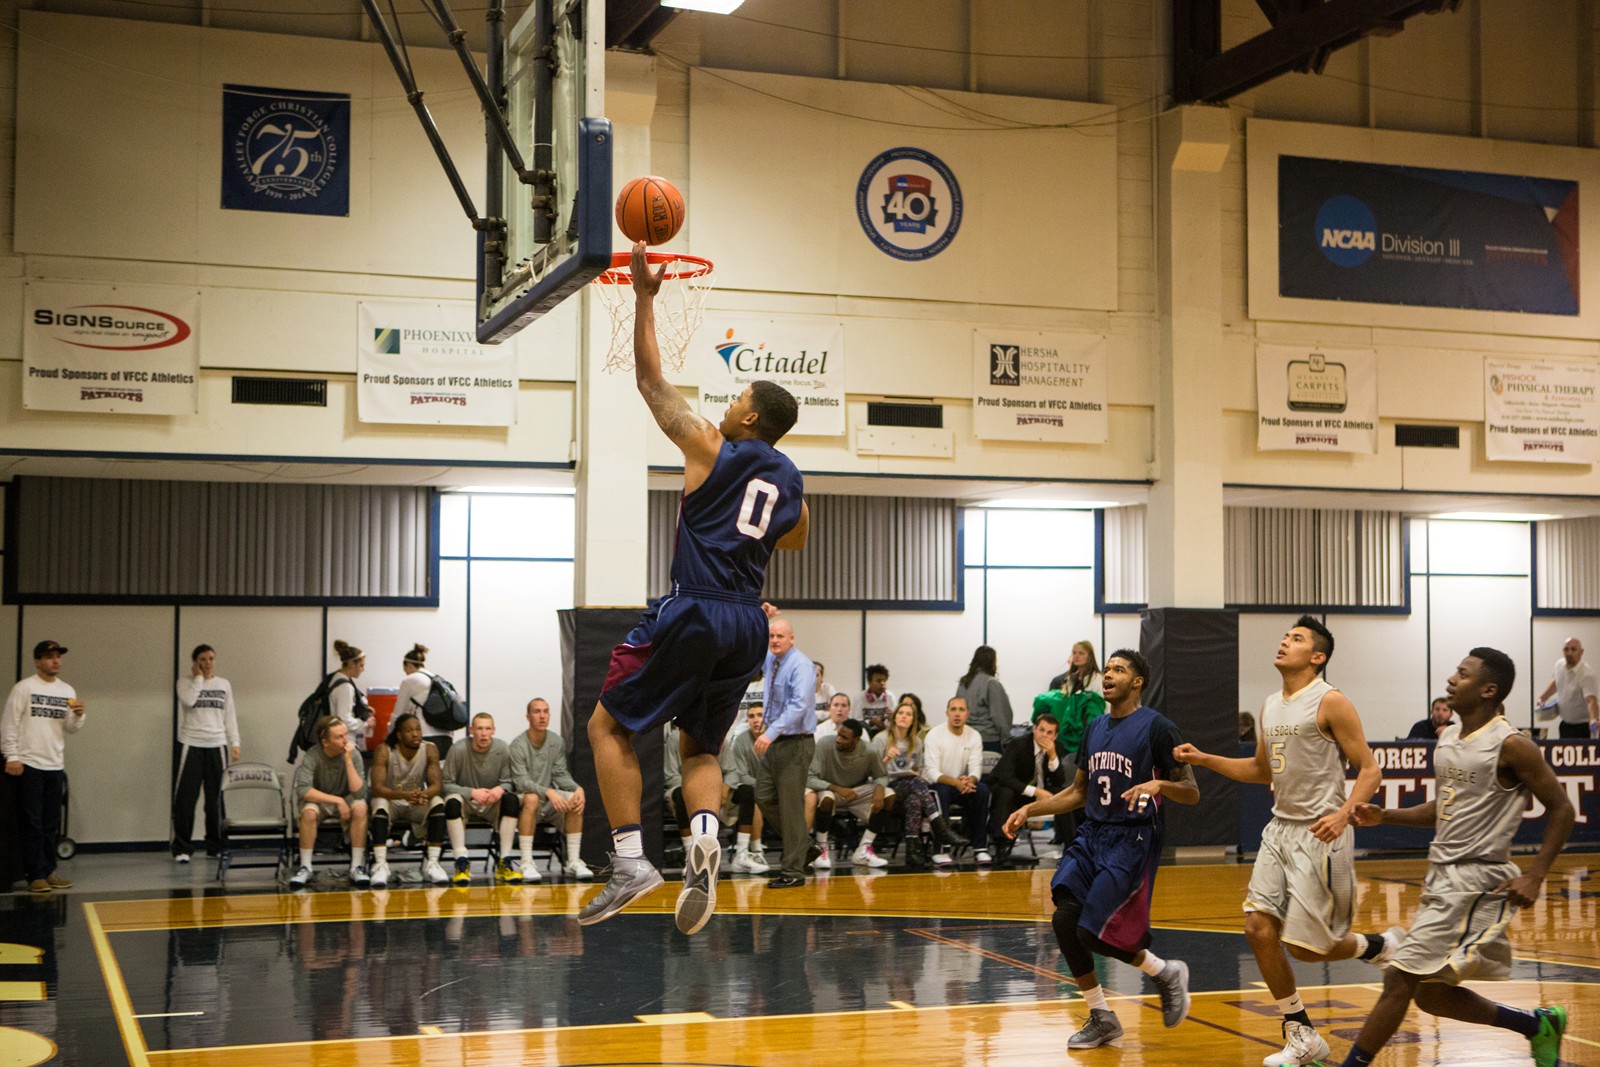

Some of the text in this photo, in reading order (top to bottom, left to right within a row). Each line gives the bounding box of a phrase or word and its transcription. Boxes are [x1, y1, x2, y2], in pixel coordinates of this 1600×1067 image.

[270, 101, 330, 133] CHRISTIAN
[887, 191, 931, 221] 40
[1321, 228, 1376, 251] NCAA
[1381, 233, 1444, 256] Division
[403, 329, 476, 342] PHOENIXV
[422, 347, 485, 356] HOSPITAL
[1020, 347, 1059, 358] HERSHA
[735, 348, 828, 374] Citadel
[1020, 361, 1091, 374] HOSPITALITY
[29, 367, 194, 384] Proud Sponsors of VFCC Athletics
[364, 373, 513, 388] Proud Sponsors of VFCC Athletics
[1020, 376, 1084, 387] MANAGEMENT
[1295, 381, 1340, 391] CARPETS
[1507, 383, 1595, 395] PHYSICAL THERAPY
[80, 390, 143, 402] PATRIOTS
[410, 395, 466, 406] PATRIOTS
[704, 393, 728, 403] Proud
[804, 397, 839, 407] Athletics
[978, 396, 1102, 411] Proud Sponsors of VFCC Athletics
[1016, 417, 1064, 427] PATRIOTS
[1261, 416, 1374, 431] Proud Sponsors of VFCC Athletics
[1489, 424, 1598, 438] Proud Sponsors of VFCC Athletics
[736, 477, 780, 540] 0
[1265, 724, 1299, 737] LLSDALE
[1270, 741, 1286, 774] 5
[1372, 747, 1427, 770] ORGE
[1097, 775, 1111, 806] 3
[1439, 784, 1456, 822] 2
